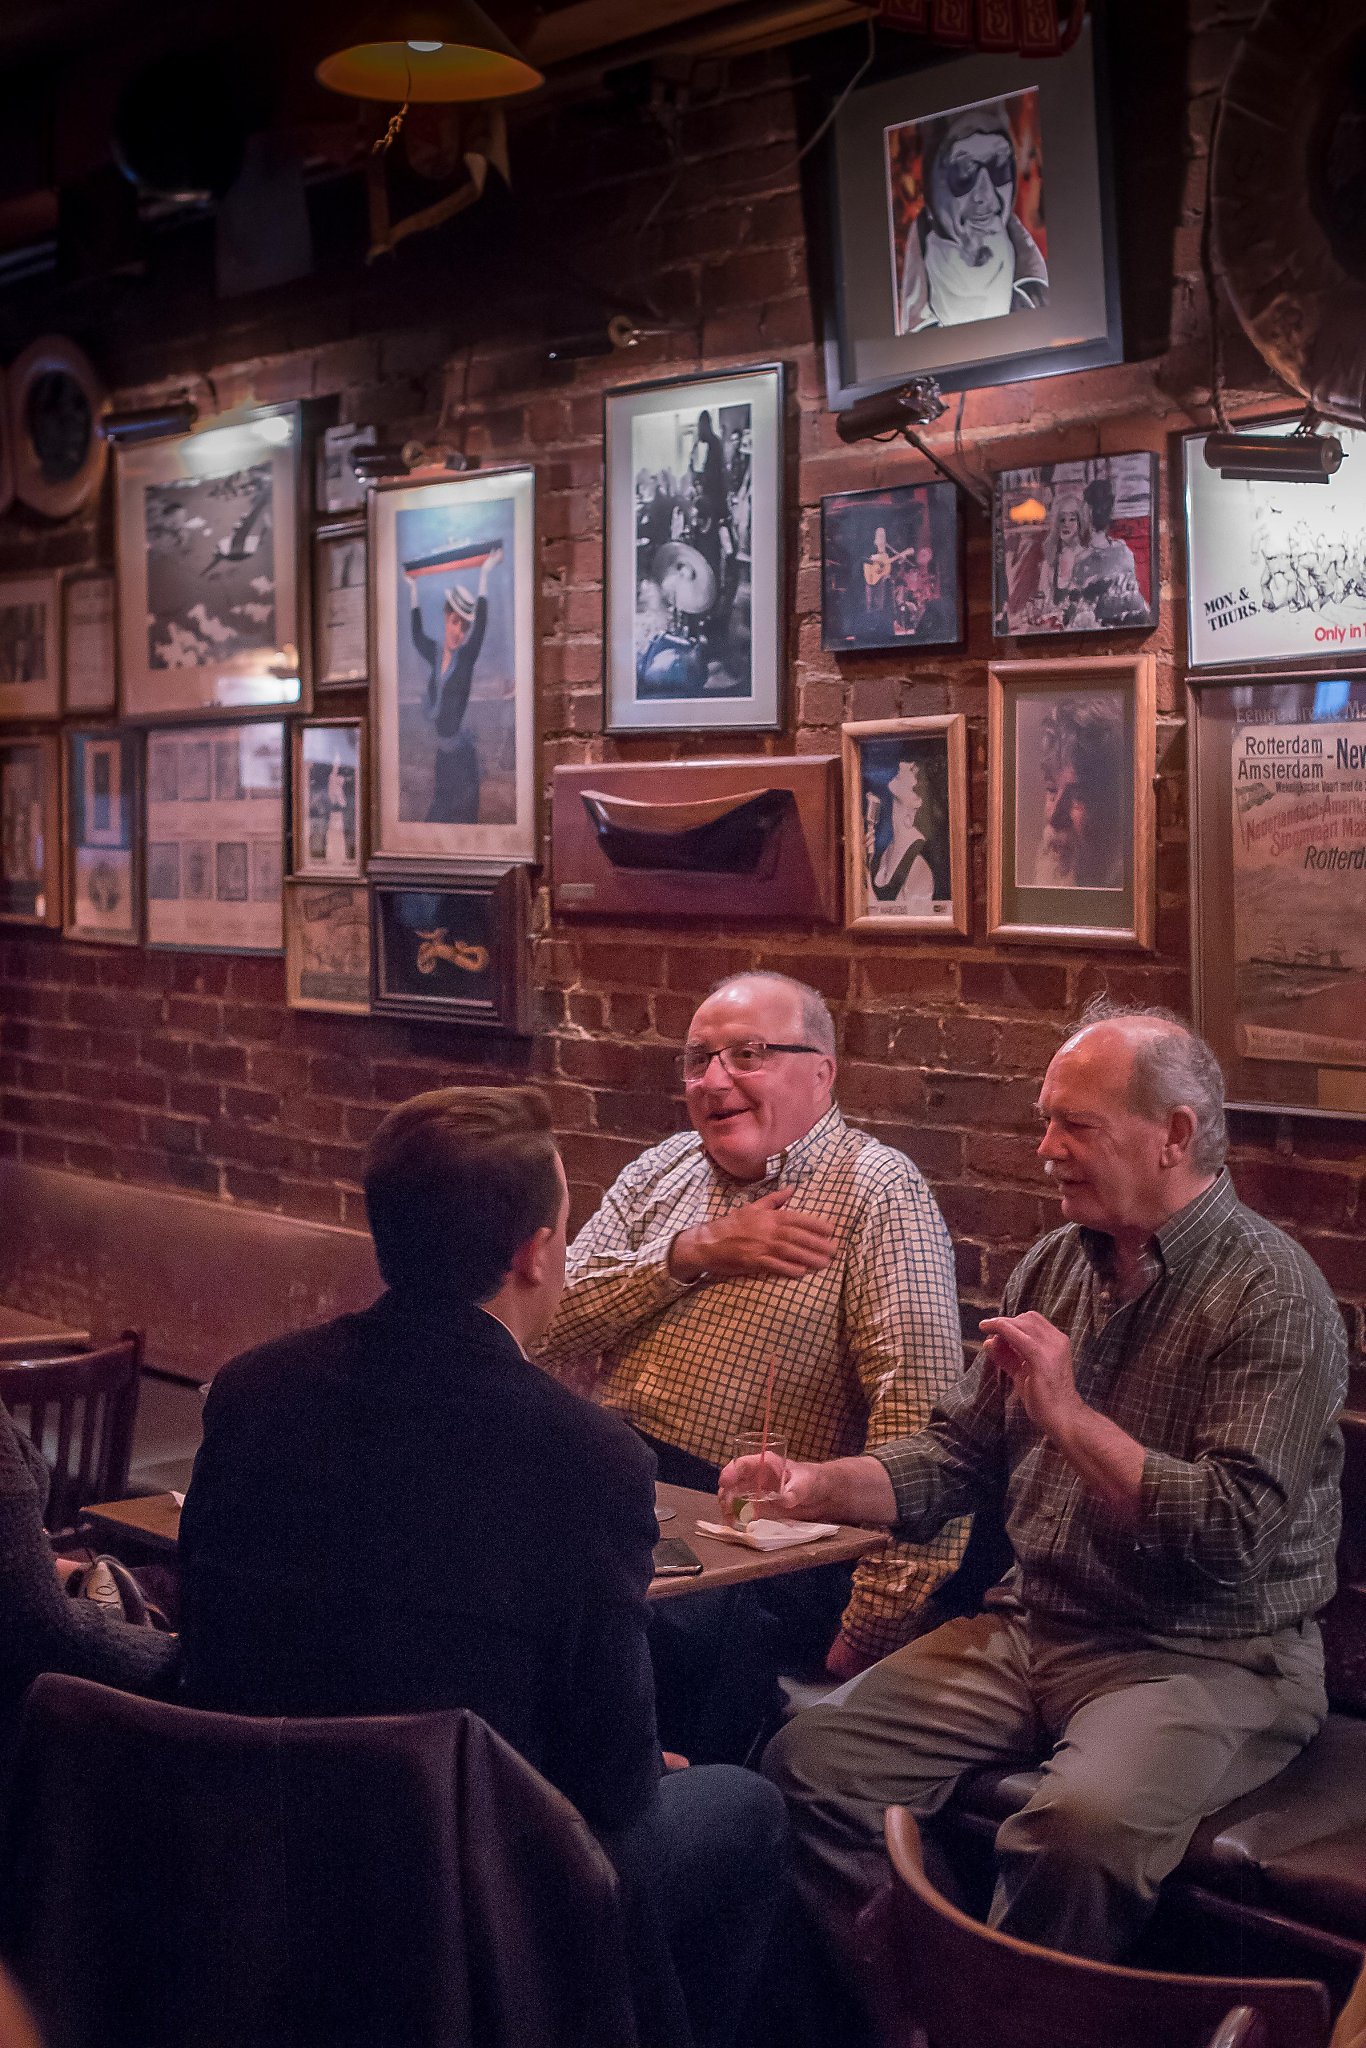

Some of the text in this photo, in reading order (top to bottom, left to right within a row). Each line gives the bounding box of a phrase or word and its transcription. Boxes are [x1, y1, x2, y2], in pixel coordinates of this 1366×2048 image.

[1204, 587, 1250, 616] MON. &
[1208, 601, 1261, 631] THURS.
[1314, 624, 1347, 643] Only
[1349, 624, 1362, 638] in
[1245, 735, 1323, 755] Rotterdam
[1238, 760, 1324, 780] Amsterdam
[1304, 845, 1366, 870] Rotterd
